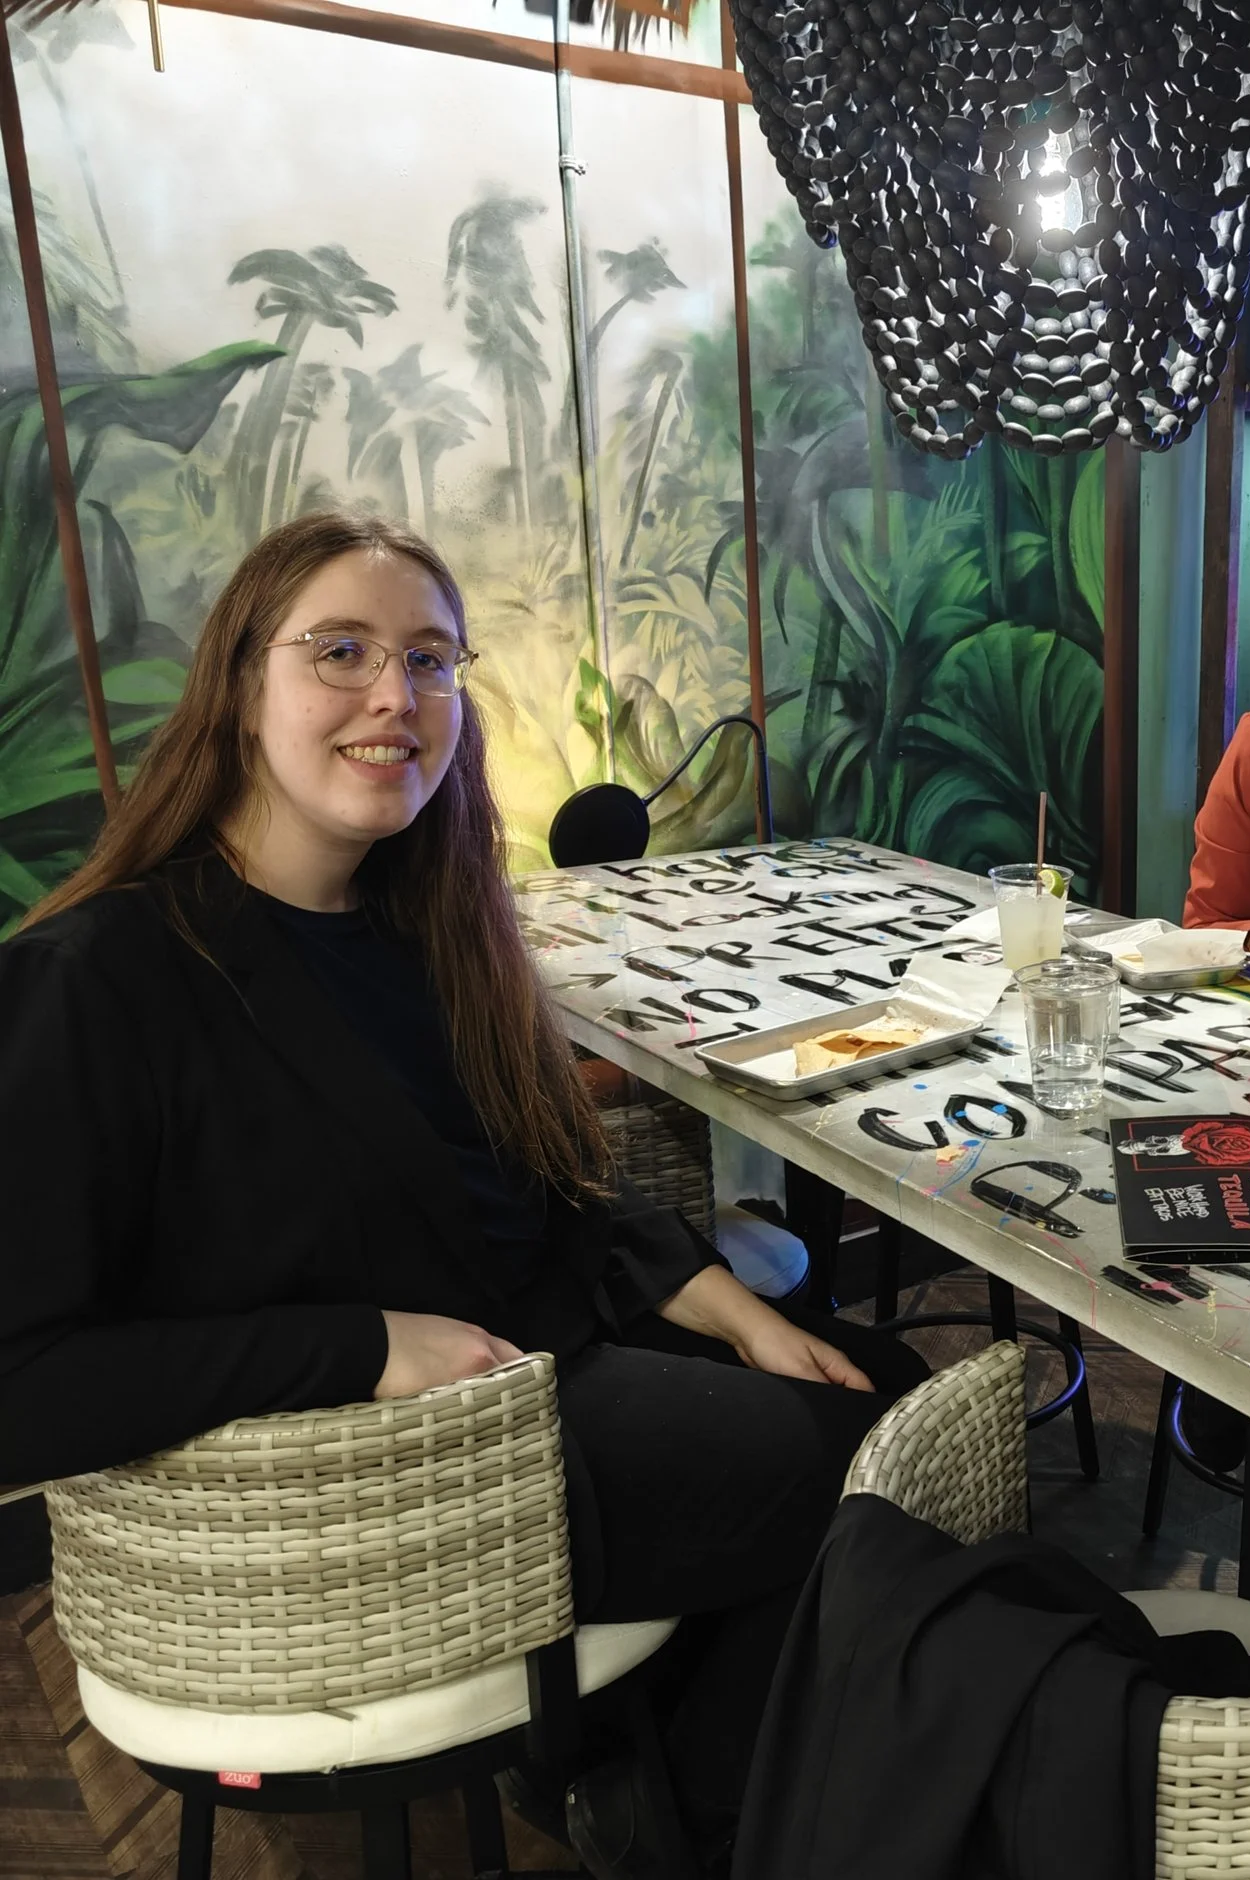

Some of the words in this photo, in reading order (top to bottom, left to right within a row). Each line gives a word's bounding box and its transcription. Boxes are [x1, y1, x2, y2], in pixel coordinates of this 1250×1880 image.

[547, 877, 757, 914] the
[623, 883, 978, 932] looking
[602, 987, 763, 1032] NO
[1143, 1187, 1166, 1203] EAT
[1163, 1187, 1185, 1201] BE
[1172, 1199, 1195, 1219] NICE
